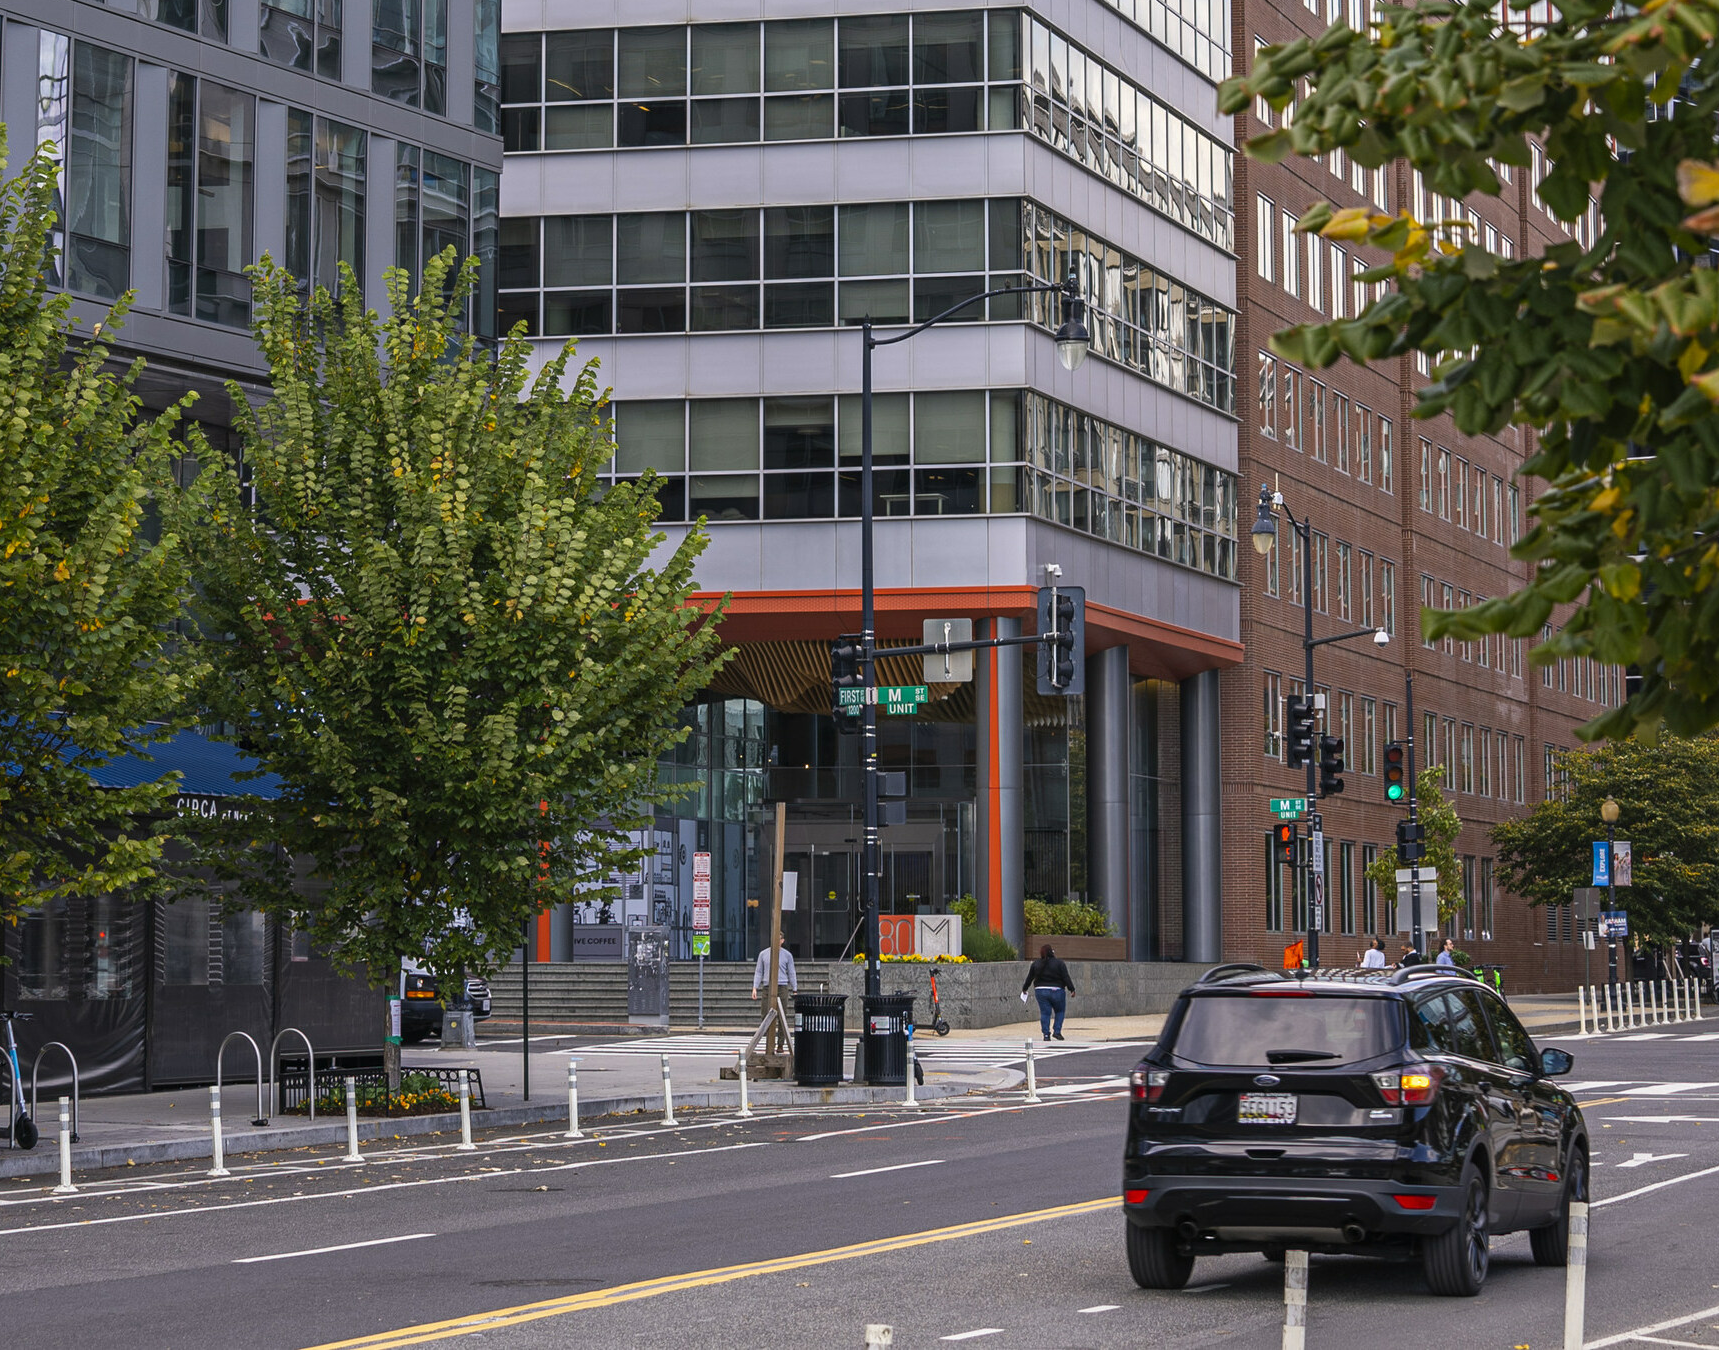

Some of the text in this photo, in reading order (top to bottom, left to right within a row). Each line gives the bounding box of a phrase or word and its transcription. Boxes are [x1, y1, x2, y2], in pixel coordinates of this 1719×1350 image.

[840, 690, 860, 704] FIRST
[888, 688, 902, 702] M
[848, 705, 860, 715] 1200
[889, 703, 914, 714] UNIT
[1280, 800, 1290, 810] M
[879, 919, 912, 956] 80
